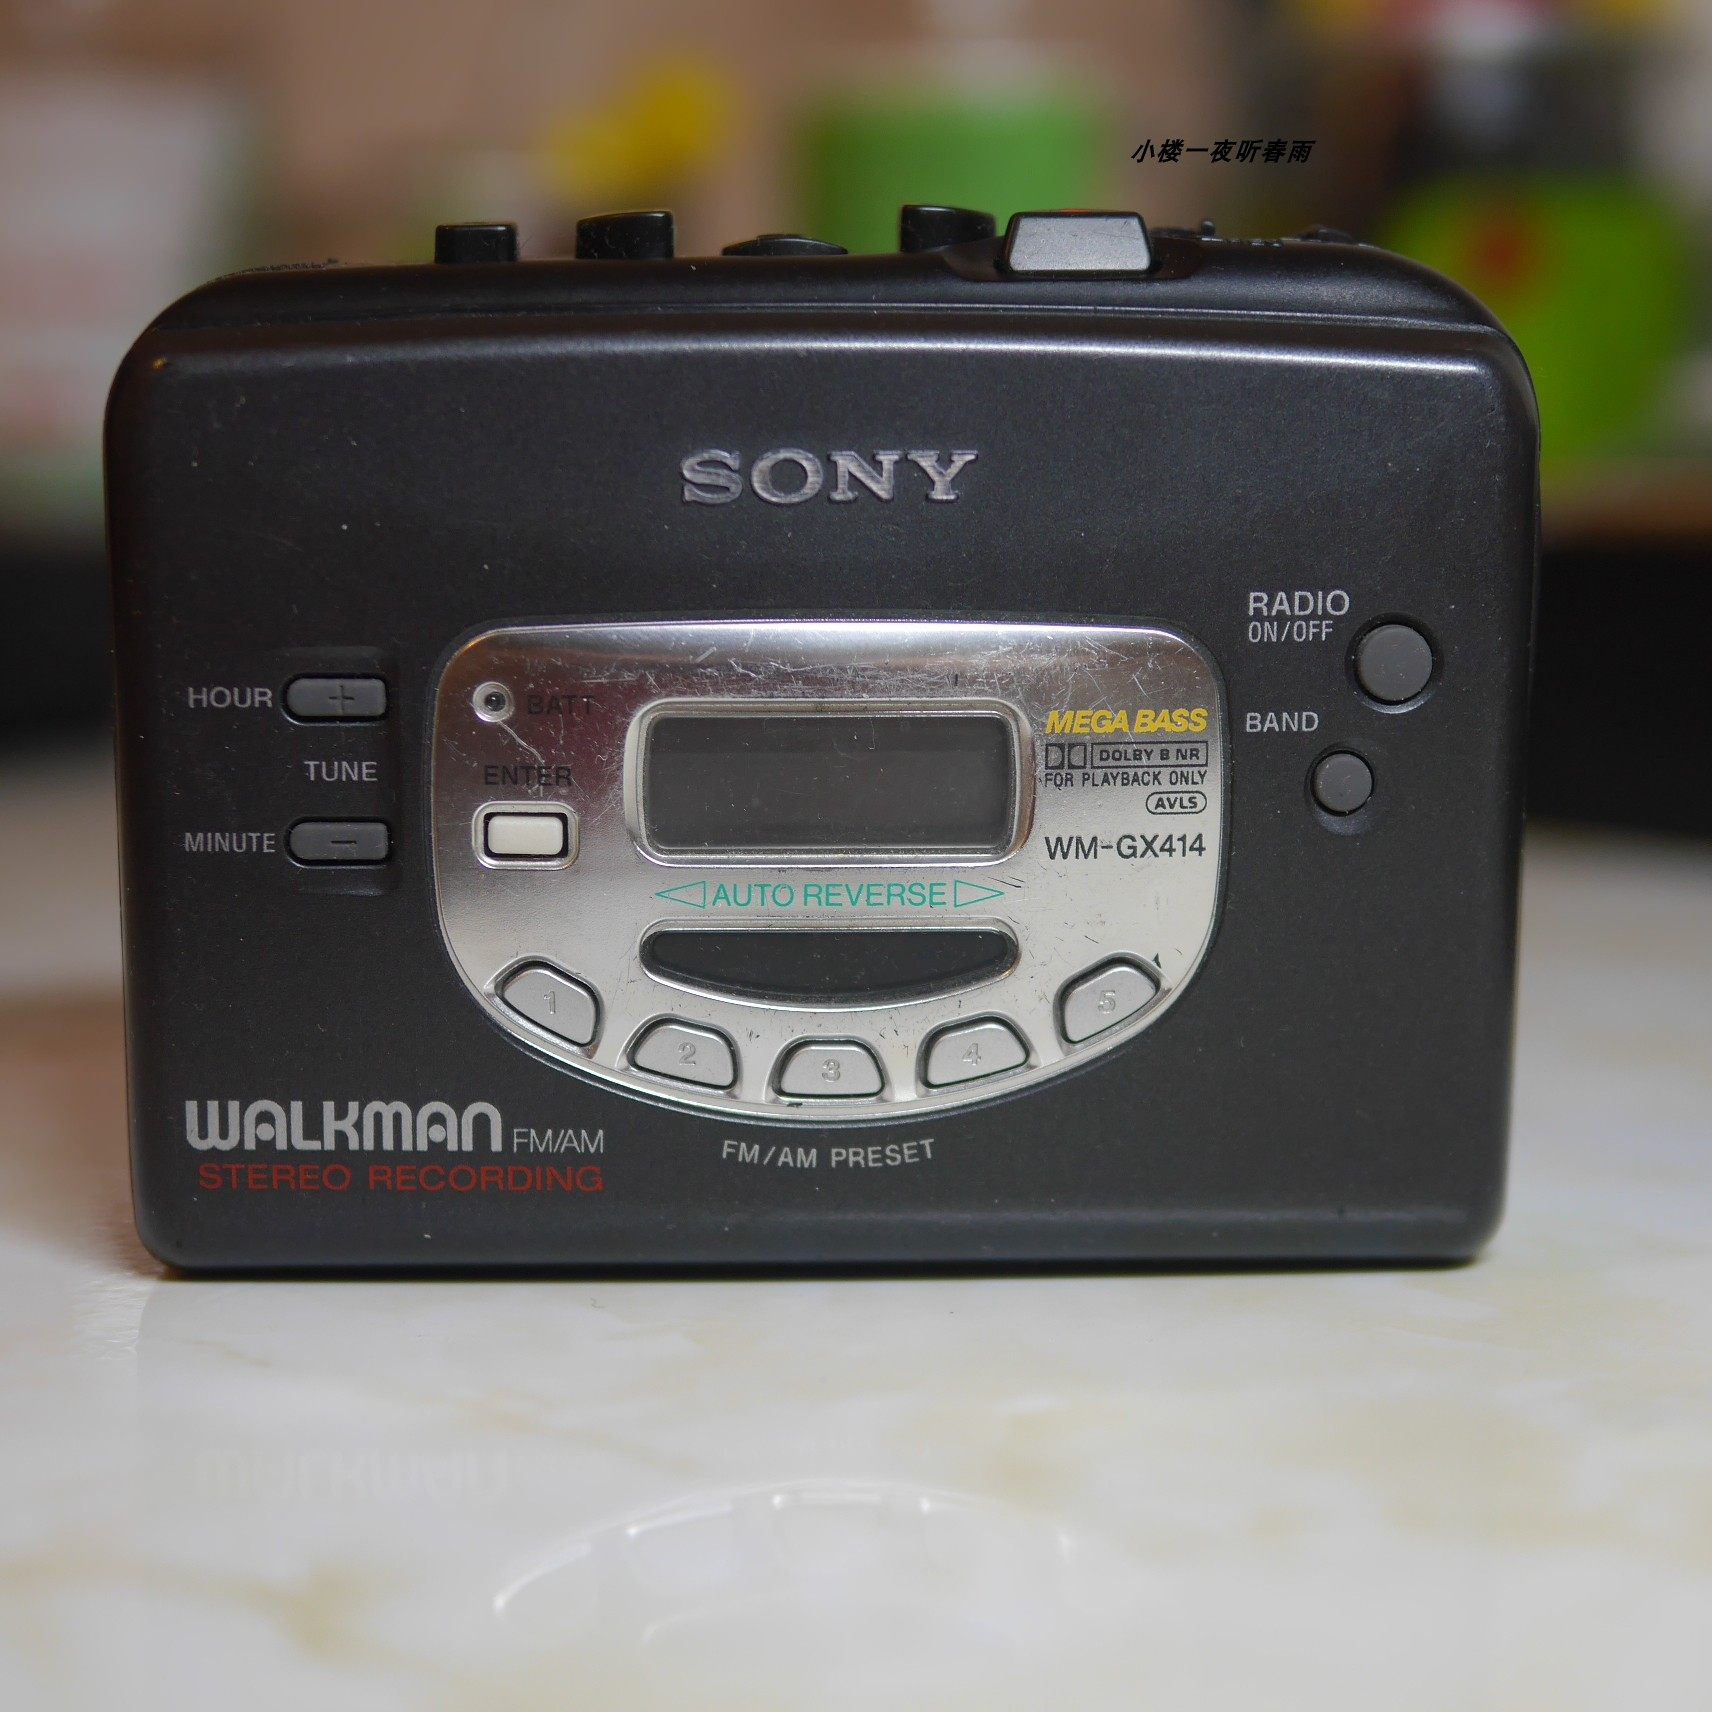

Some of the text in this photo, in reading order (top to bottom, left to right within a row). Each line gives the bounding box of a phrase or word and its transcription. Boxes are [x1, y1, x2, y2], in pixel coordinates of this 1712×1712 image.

[680, 447, 978, 505] SONY
[1248, 590, 1350, 616] RADIO
[1248, 620, 1334, 643] ON/OFF
[187, 686, 273, 709] HOUR
[527, 694, 597, 716] BATT
[1045, 709, 1208, 735] MEGA BASS
[1245, 711, 1320, 733] BAND
[1099, 746, 1200, 763] DOLBY B NR
[304, 760, 378, 782] TUNE
[484, 764, 573, 787] ENTER
[1044, 769, 1208, 788] FOR PLAYBACK ONLY
[1153, 797, 1199, 811] AVLS
[184, 831, 277, 854] MINUTE
[1044, 834, 1207, 861] WM-GX414
[712, 882, 947, 908] AUTO REVERSE
[677, 1042, 697, 1067] 2
[962, 1042, 983, 1067] 4
[822, 1058, 842, 1083] 3
[184, 1099, 605, 1154] WALKMAN FM/AM
[721, 1137, 937, 1170] FM/AM PRESET
[199, 1162, 606, 1193] STEREO RECORDING
